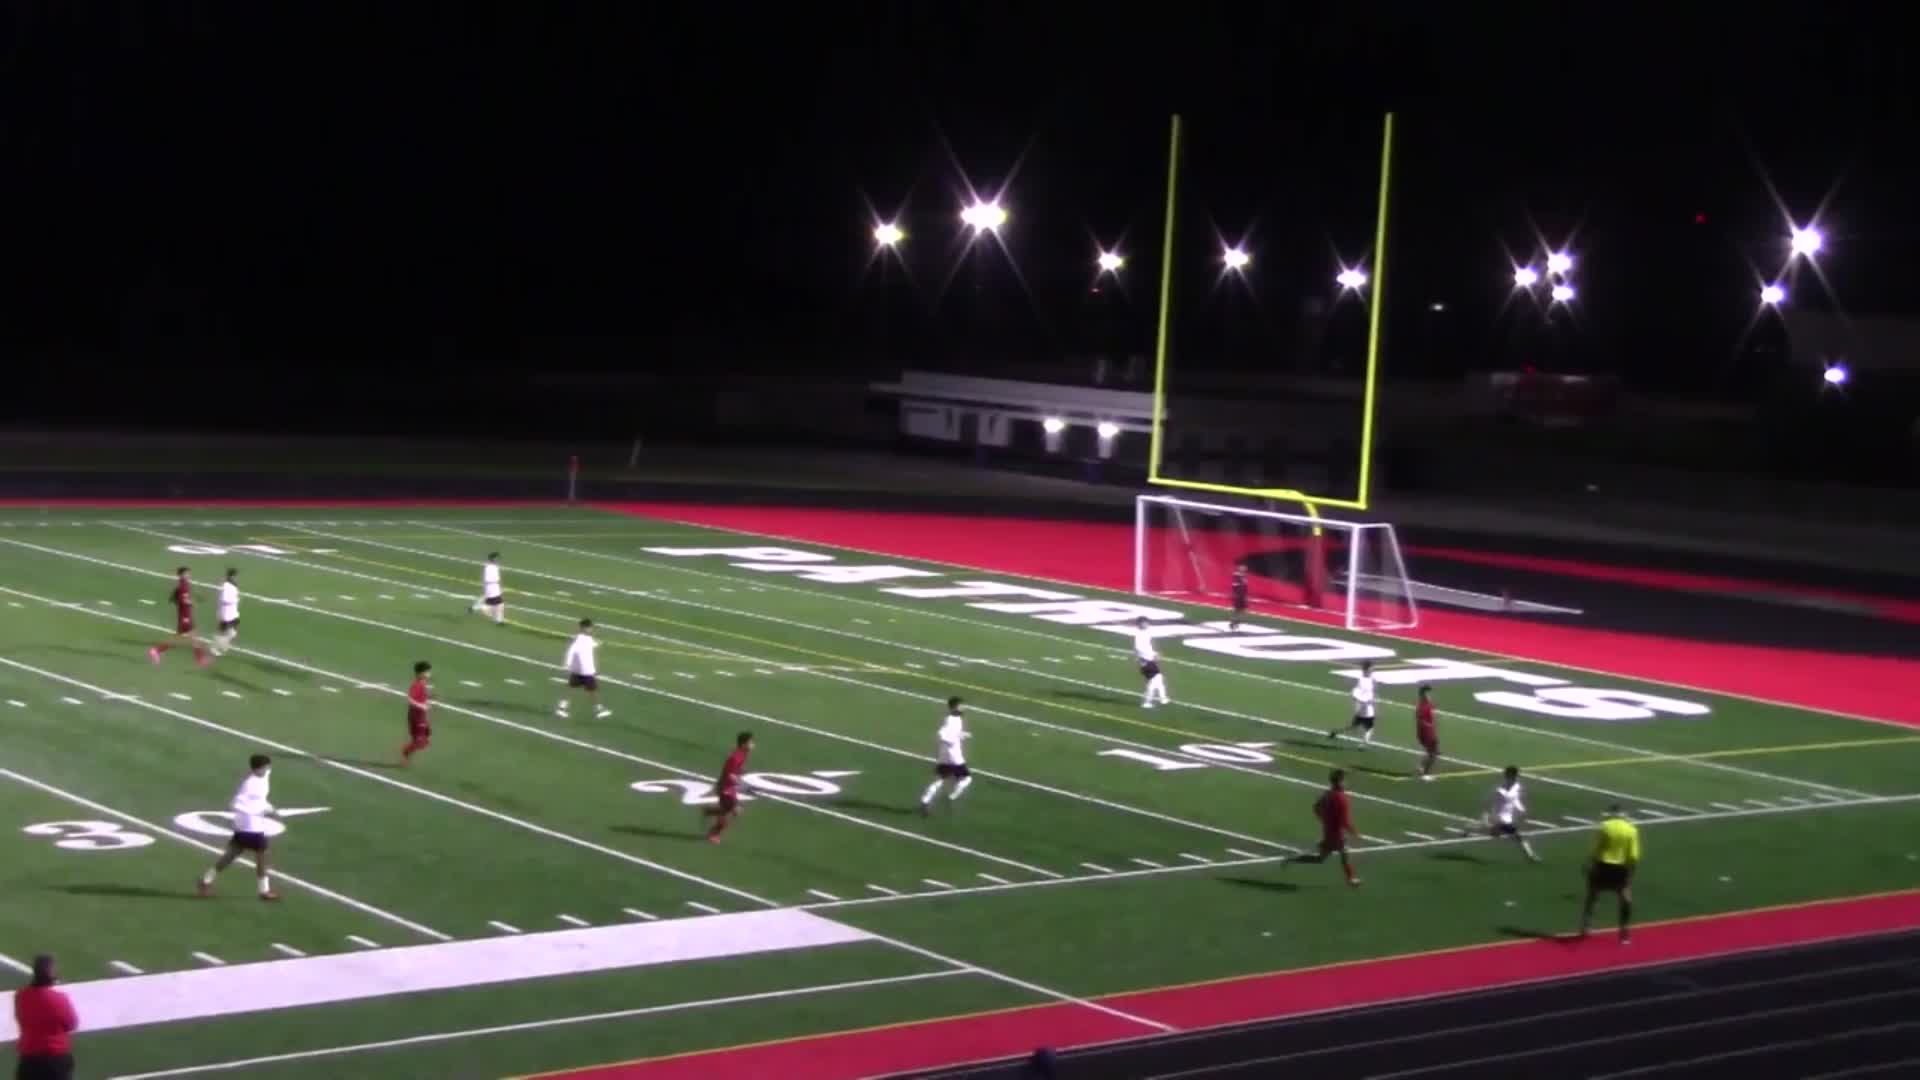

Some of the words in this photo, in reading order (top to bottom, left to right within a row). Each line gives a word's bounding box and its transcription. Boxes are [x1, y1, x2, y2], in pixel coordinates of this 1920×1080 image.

[641, 546, 1711, 720] PATRIOTS
[1097, 744, 1274, 770] 10
[630, 773, 841, 805] 20
[22, 811, 286, 850] 30
